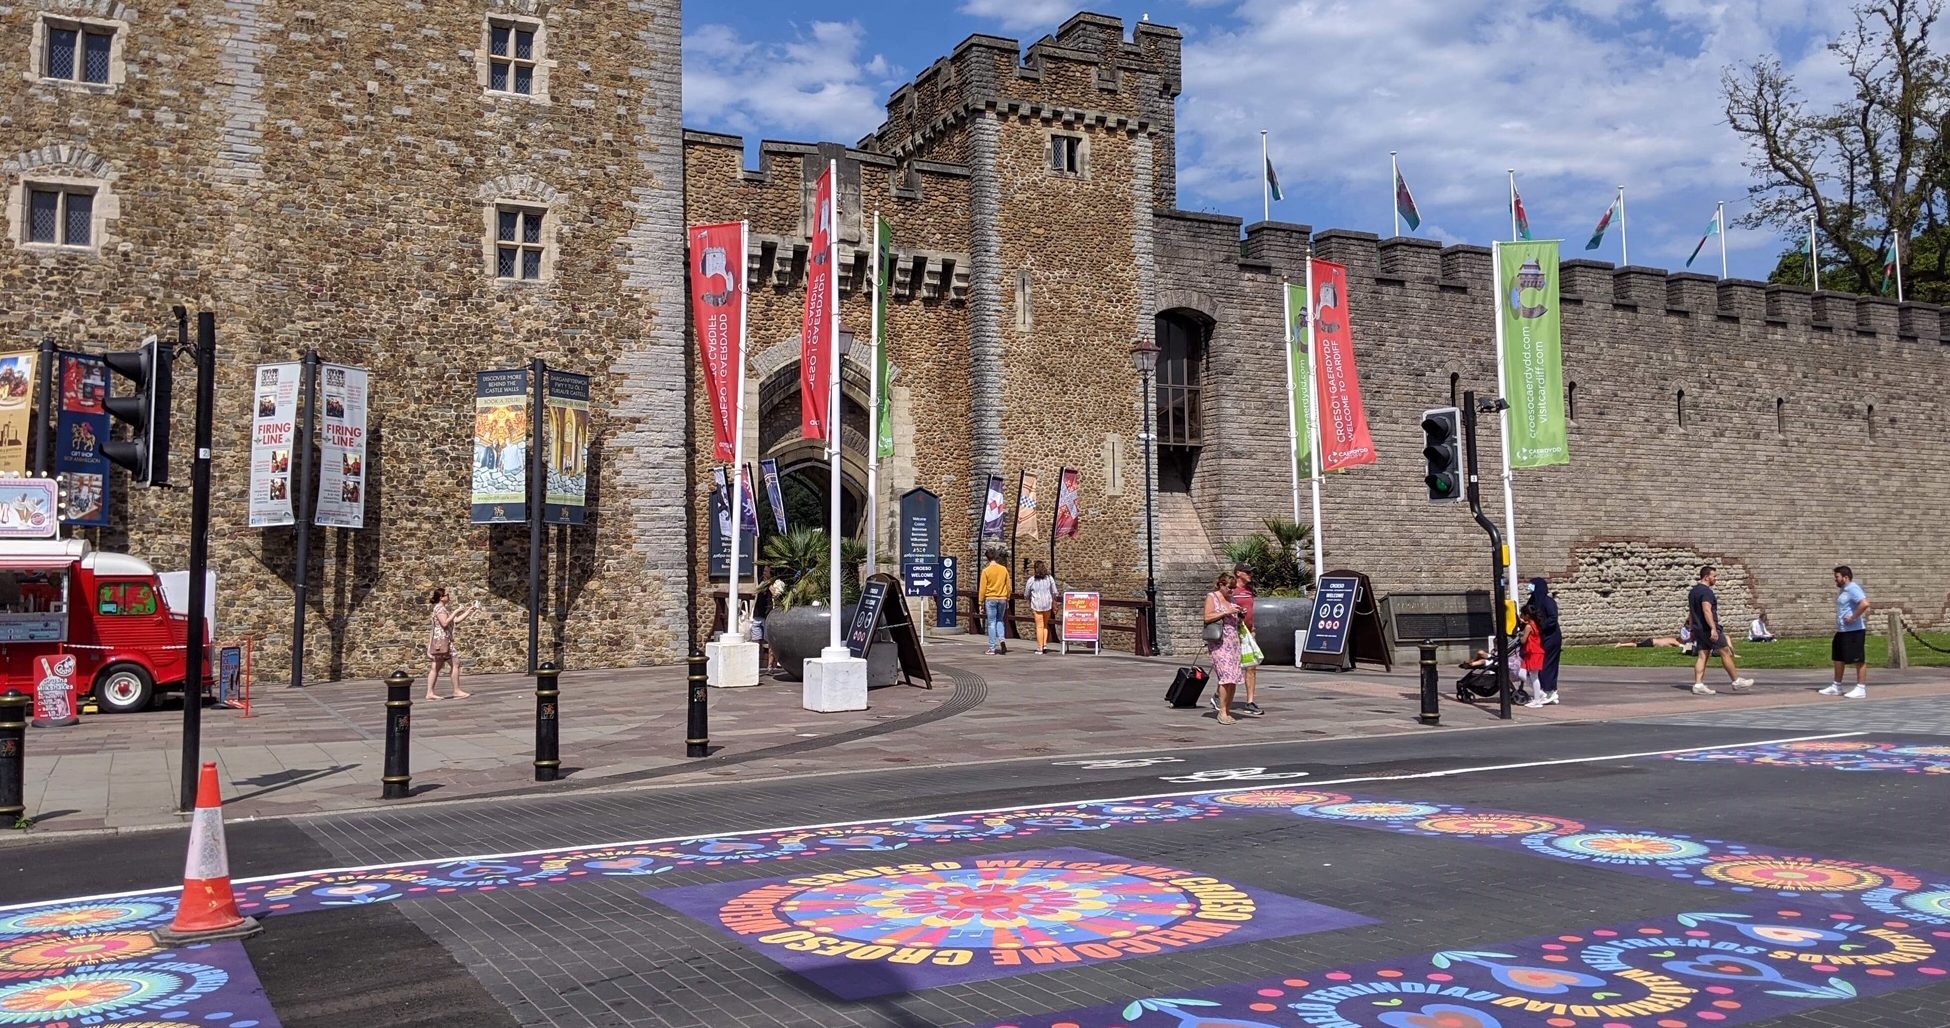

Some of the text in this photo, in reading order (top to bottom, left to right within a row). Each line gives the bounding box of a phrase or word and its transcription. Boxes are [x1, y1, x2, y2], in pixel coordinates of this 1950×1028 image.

[1322, 340, 1338, 394] GAERDYDD
[1522, 326, 1536, 439] croesocaerdydd.com
[1536, 342, 1548, 424] visitcardiff.com
[1331, 340, 1354, 442] WELCOME TO CARDIFF
[258, 422, 292, 434] FIRING
[262, 434, 284, 445] LINE
[326, 424, 362, 437] FIRING
[1332, 401, 1346, 443] CROESO
[332, 436, 354, 448] LINE
[788, 859, 1194, 886] CROESO WELCOME
[719, 884, 974, 966] CROESO WELCOME
[989, 876, 1257, 966] CROESO WELCOME
[1580, 938, 1768, 971] HELLO FRIENDS
[1768, 928, 1936, 965] HELLO FRIENDS
[1302, 982, 1502, 1004] FFRINDIAU
[1490, 968, 1700, 1018] HELÔ FFRINDIAU
[80, 1008, 148, 1025] ETO
